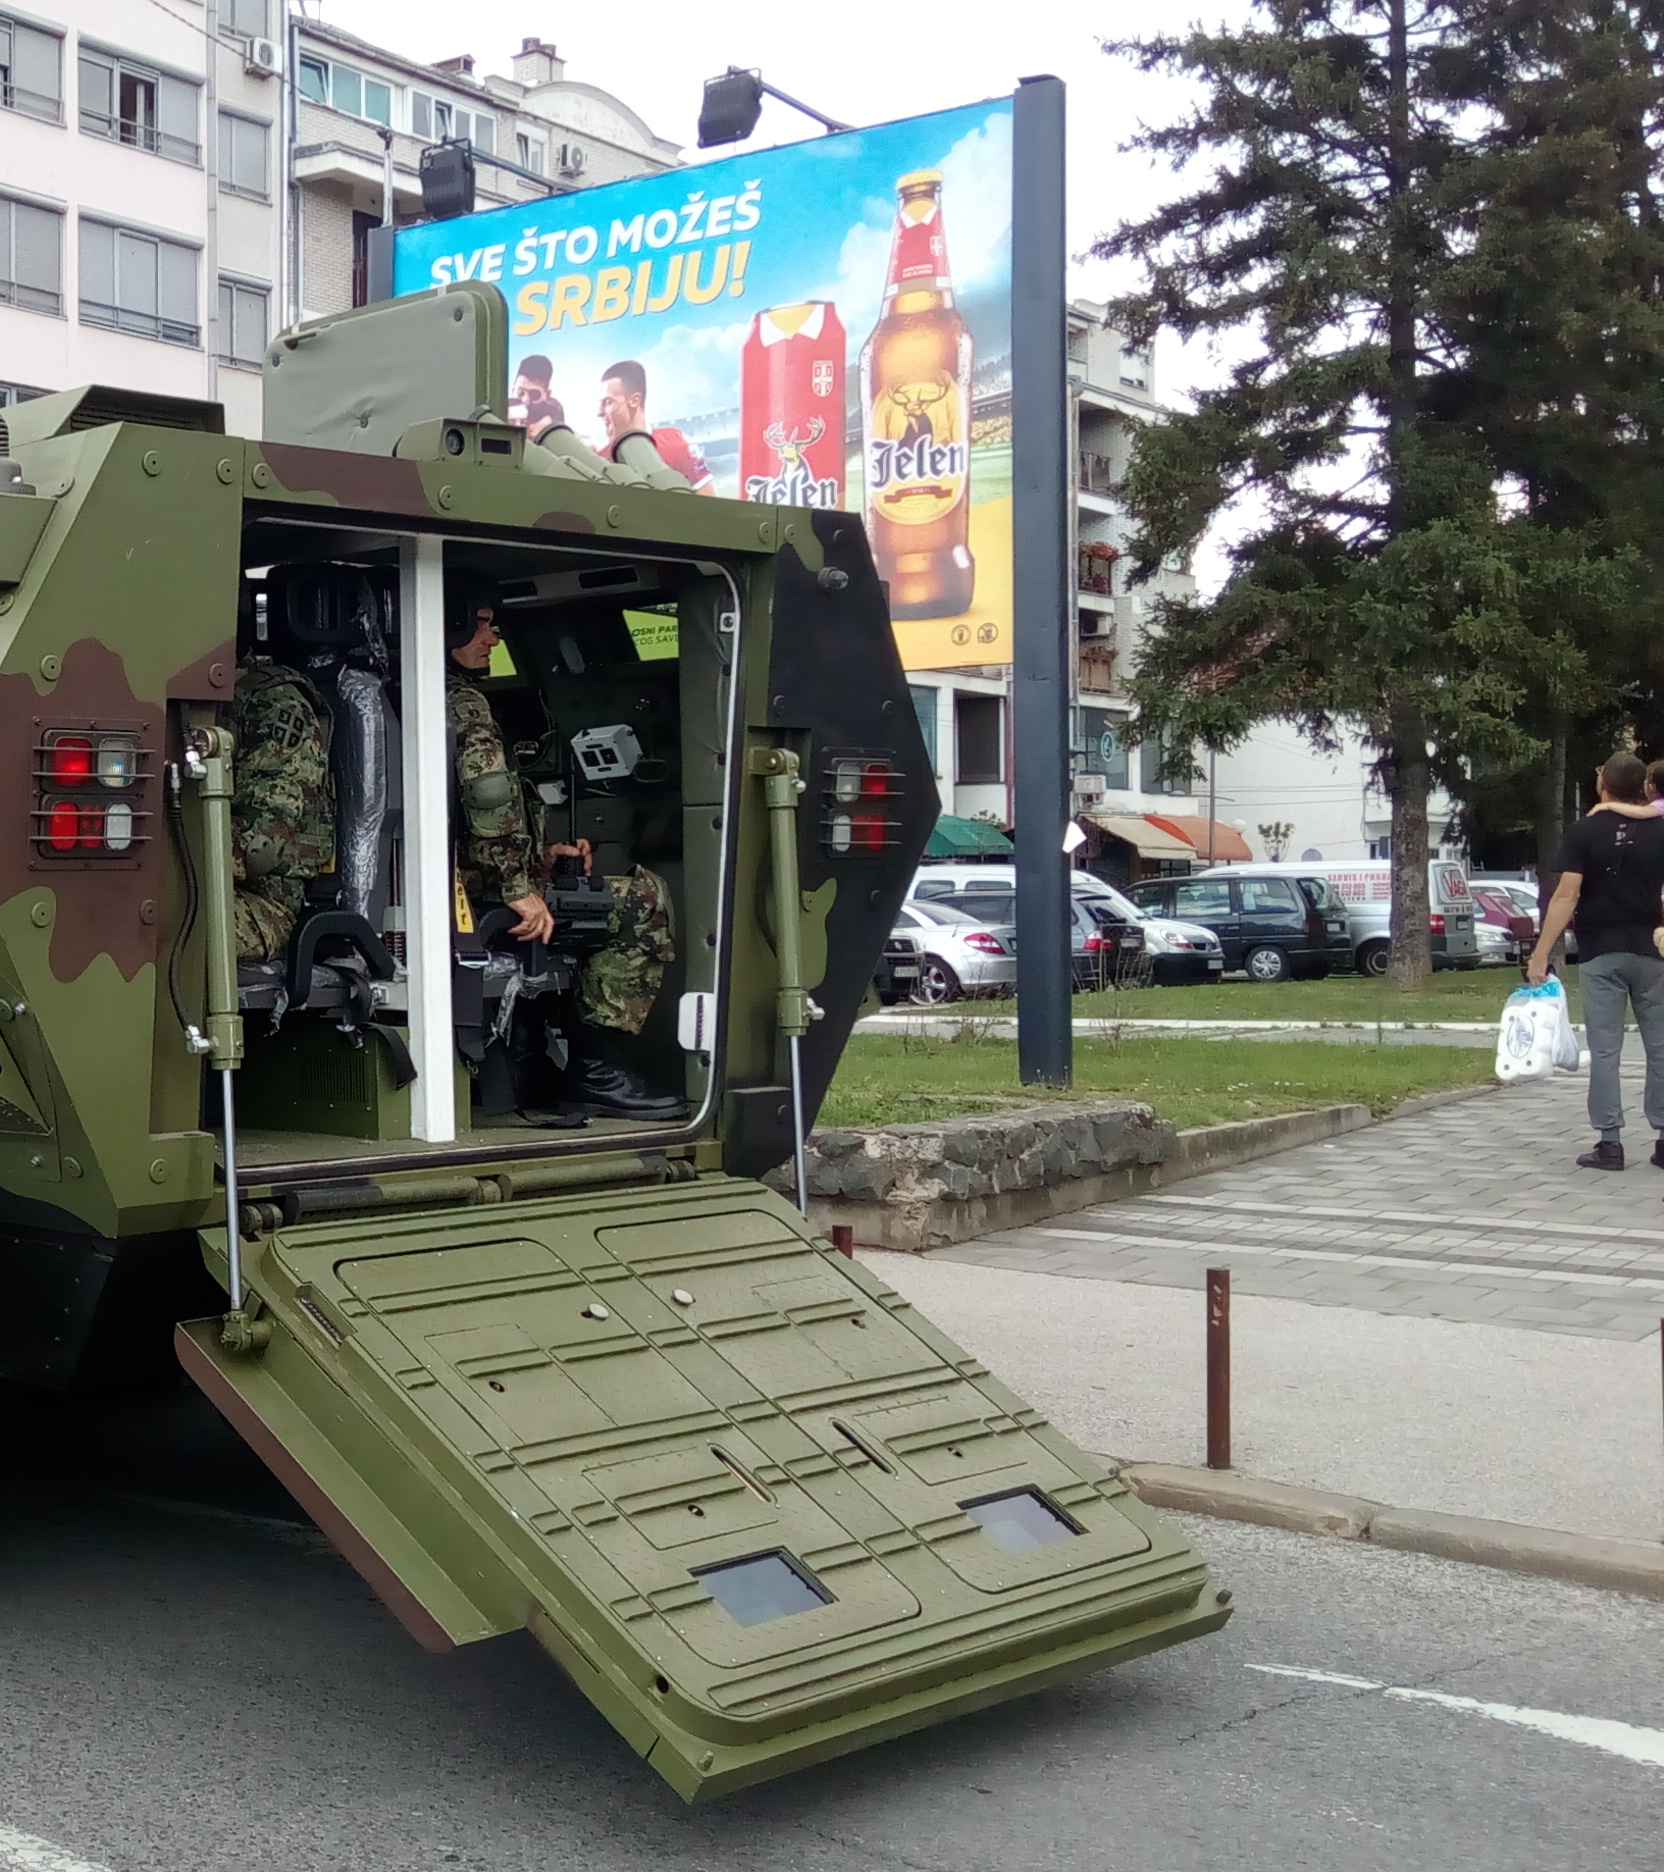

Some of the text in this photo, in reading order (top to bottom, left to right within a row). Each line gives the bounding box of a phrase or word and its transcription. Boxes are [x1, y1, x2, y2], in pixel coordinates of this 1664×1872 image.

[430, 179, 762, 289] SVE ŠTO MOŽEŠ
[513, 240, 752, 336] SRBIJU!
[871, 434, 965, 489] Jelen
